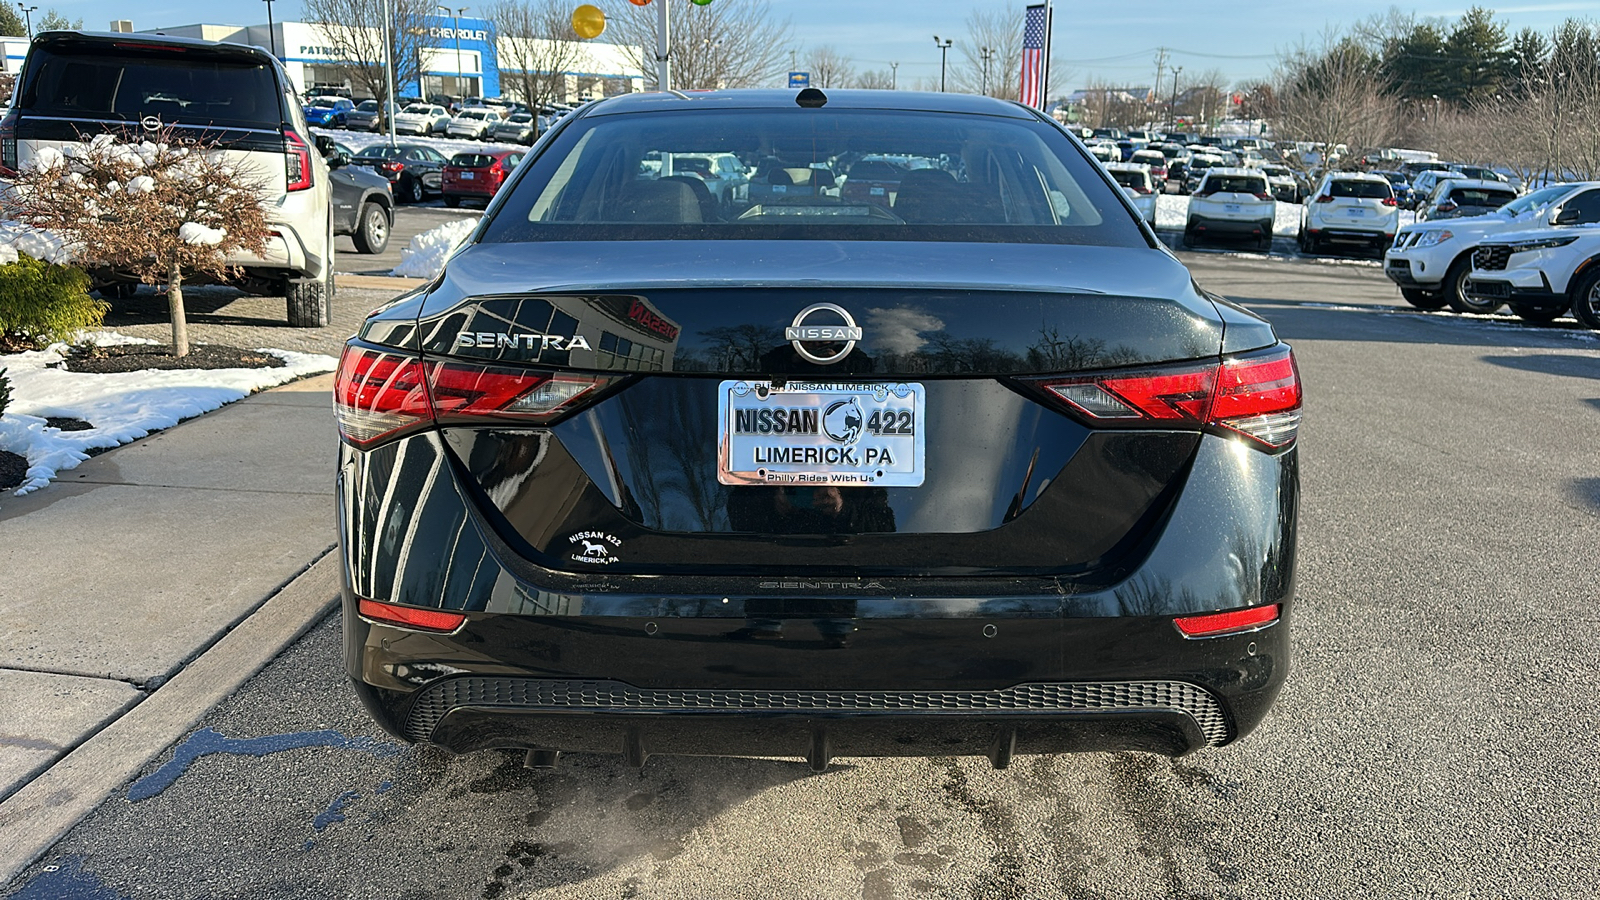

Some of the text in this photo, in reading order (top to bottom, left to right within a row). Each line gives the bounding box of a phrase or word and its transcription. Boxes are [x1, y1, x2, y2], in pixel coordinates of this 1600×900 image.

[430, 27, 487, 41] CHEVROLET
[788, 329, 860, 339] NISSAN
[457, 331, 592, 351] SENTRA
[789, 383, 833, 391] NISSAN
[735, 408, 913, 435] NISSAN 422
[755, 448, 893, 465] LIMERICK, PA
[767, 474, 796, 482] Philly
[798, 474, 829, 482] Rides
[831, 474, 858, 482] With
[568, 531, 622, 547] NISSAN 422
[571, 554, 608, 565] LIMERICK,
[760, 581, 886, 589] SENTRA
